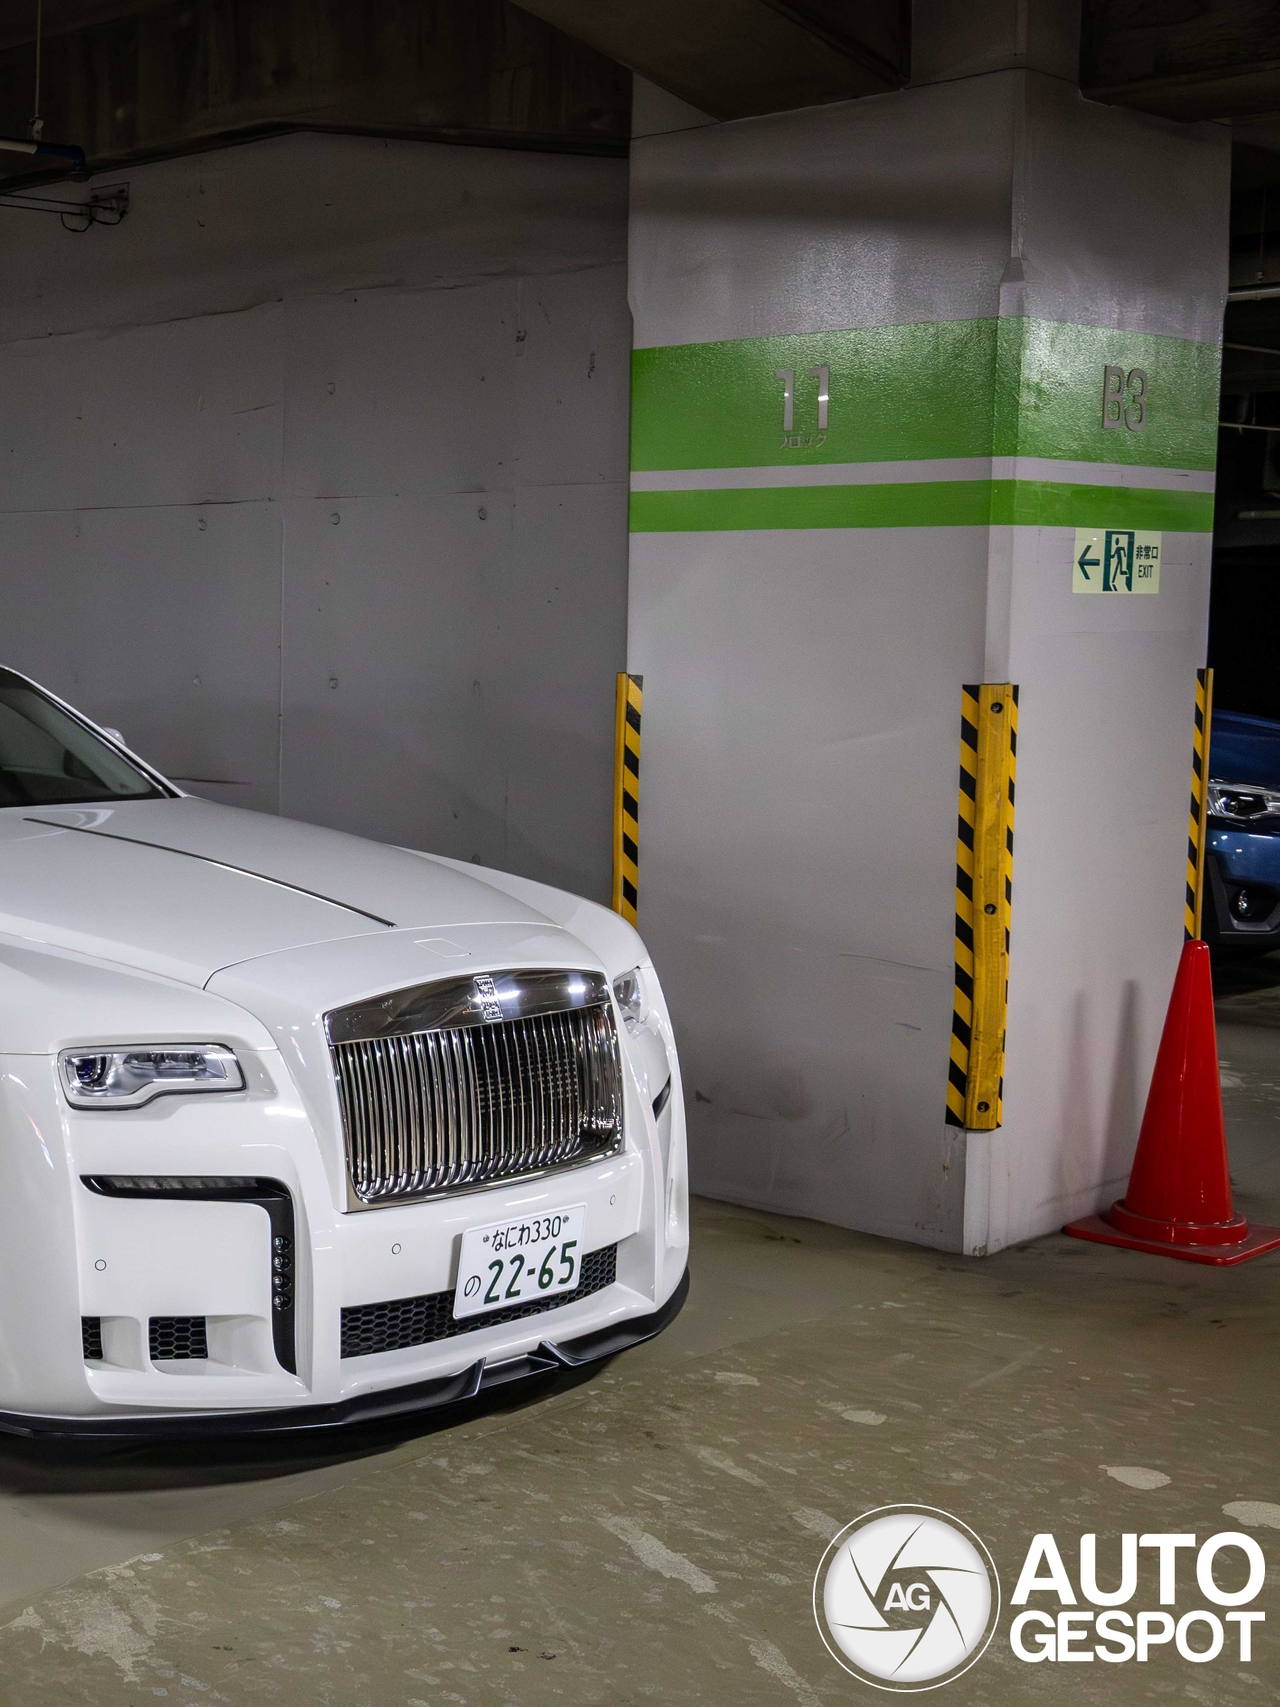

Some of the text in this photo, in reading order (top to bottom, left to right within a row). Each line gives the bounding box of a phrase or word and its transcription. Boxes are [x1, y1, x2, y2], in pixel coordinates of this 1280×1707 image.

[774, 366, 829, 431] 11
[1102, 365, 1148, 431] B3
[1135, 545, 1159, 560] 非常口
[1138, 564, 1154, 578] EXIT
[483, 1240, 577, 1304] 22-65
